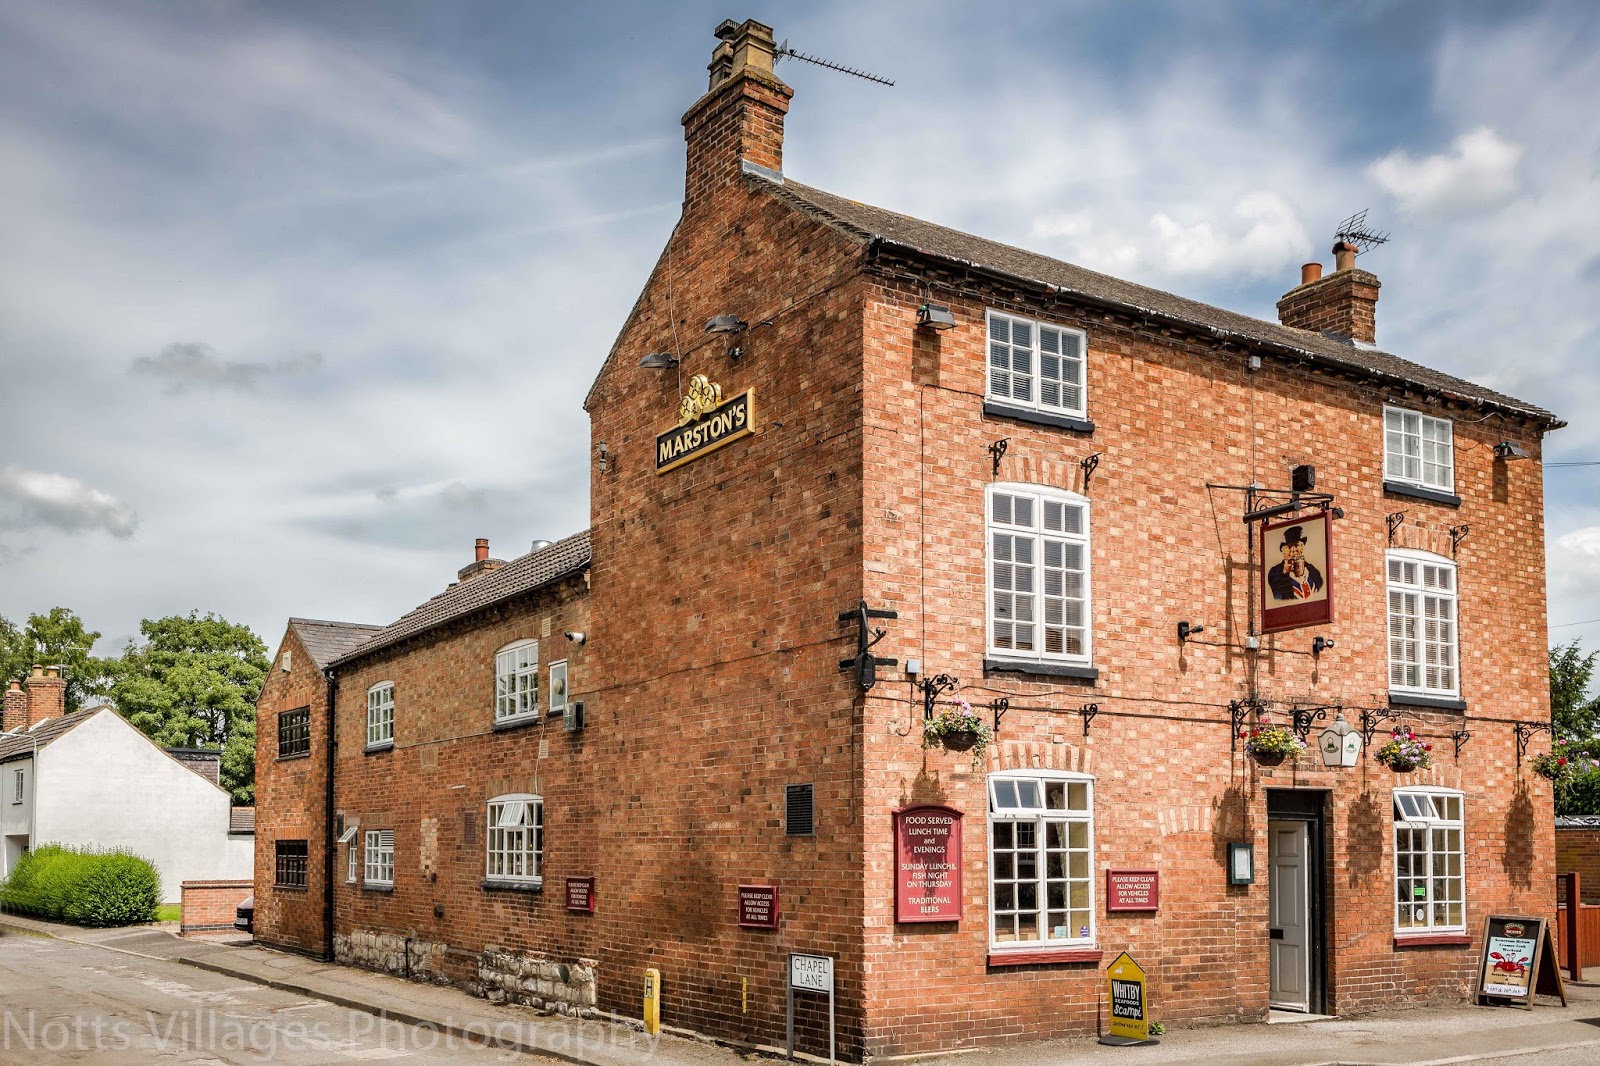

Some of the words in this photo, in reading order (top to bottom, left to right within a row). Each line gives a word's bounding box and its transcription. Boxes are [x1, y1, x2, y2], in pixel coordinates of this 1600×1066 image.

[659, 404, 746, 462] MARSTON'S
[906, 816, 926, 824] FOOD
[928, 816, 953, 825] SERVED
[794, 958, 827, 974] CHAPEL
[646, 979, 652, 995] H
[800, 972, 822, 987] LANE
[1112, 980, 1140, 1000] WHITBY
[1114, 1004, 1142, 1020] Scampi
